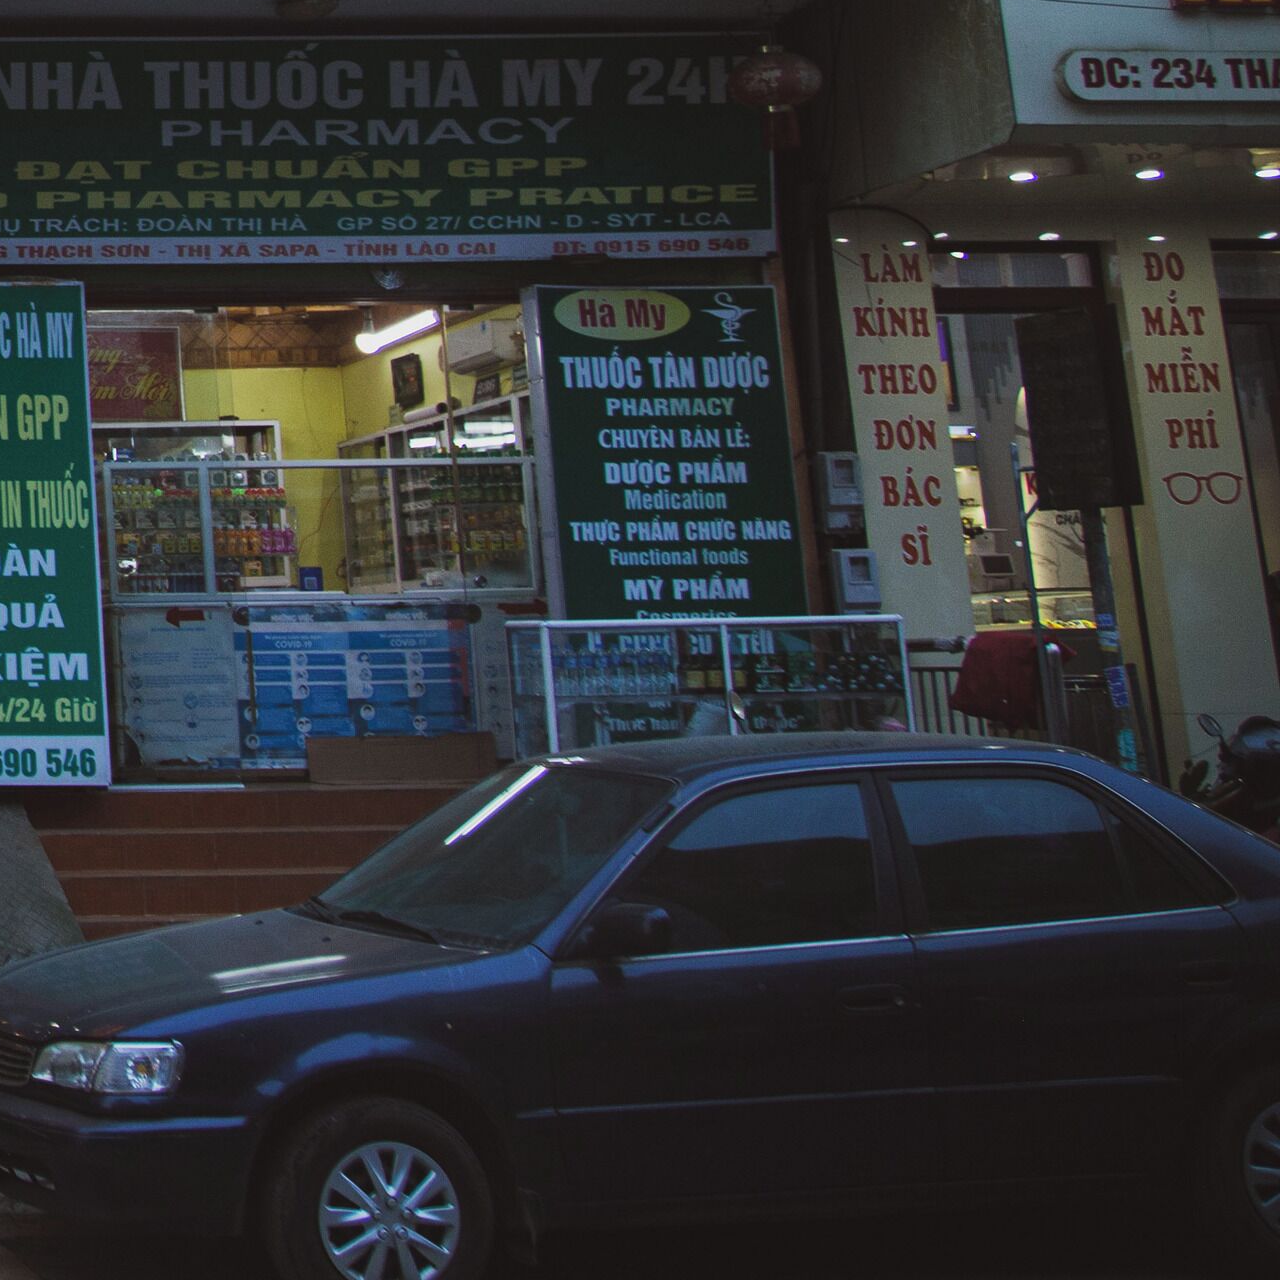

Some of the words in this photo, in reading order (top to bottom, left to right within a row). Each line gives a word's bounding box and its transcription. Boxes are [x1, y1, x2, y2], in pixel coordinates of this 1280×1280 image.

[143, 44, 364, 111] THUỐC
[387, 50, 480, 109] HÀ
[501, 58, 603, 108] MY
[1080, 57, 1141, 89] ĐC:
[1151, 58, 1217, 89] 234
[161, 116, 575, 148] PHARMACY
[13, 160, 152, 185] ĐẠT
[175, 151, 422, 181] CHUẨN
[447, 156, 588, 178] GPP
[36, 188, 444, 211] PHARMACY
[468, 183, 759, 207] PRATICE
[861, 245, 923, 284] LÀM
[1143, 252, 1185, 282] ĐO
[16, 300, 42, 359] HÀ
[45, 311, 75, 359] MY
[578, 297, 617, 328] Hà
[625, 297, 667, 332] My
[853, 298, 931, 338] KÍNH
[1141, 290, 1206, 337] MẮT
[559, 344, 643, 389] THUỐC
[648, 351, 697, 389] TÂN
[702, 350, 771, 395] DƯỢC
[859, 364, 937, 395] THEO
[1144, 346, 1221, 394] MIỄN
[15, 394, 70, 441] GPP
[605, 397, 736, 417] PHARMACY
[874, 415, 936, 451] ĐƠN
[1165, 410, 1220, 449] PHÍ
[604, 458, 672, 489] DƯỢC
[679, 453, 748, 485] PHẨM
[880, 467, 942, 508] BÁC
[26, 462, 90, 529] THUỐC
[624, 488, 728, 511] Medication
[608, 547, 698, 566] Functional
[702, 547, 749, 566] foods
[901, 524, 933, 566] SĨ
[54, 695, 98, 724] Giờ
[46, 747, 97, 778] 546
